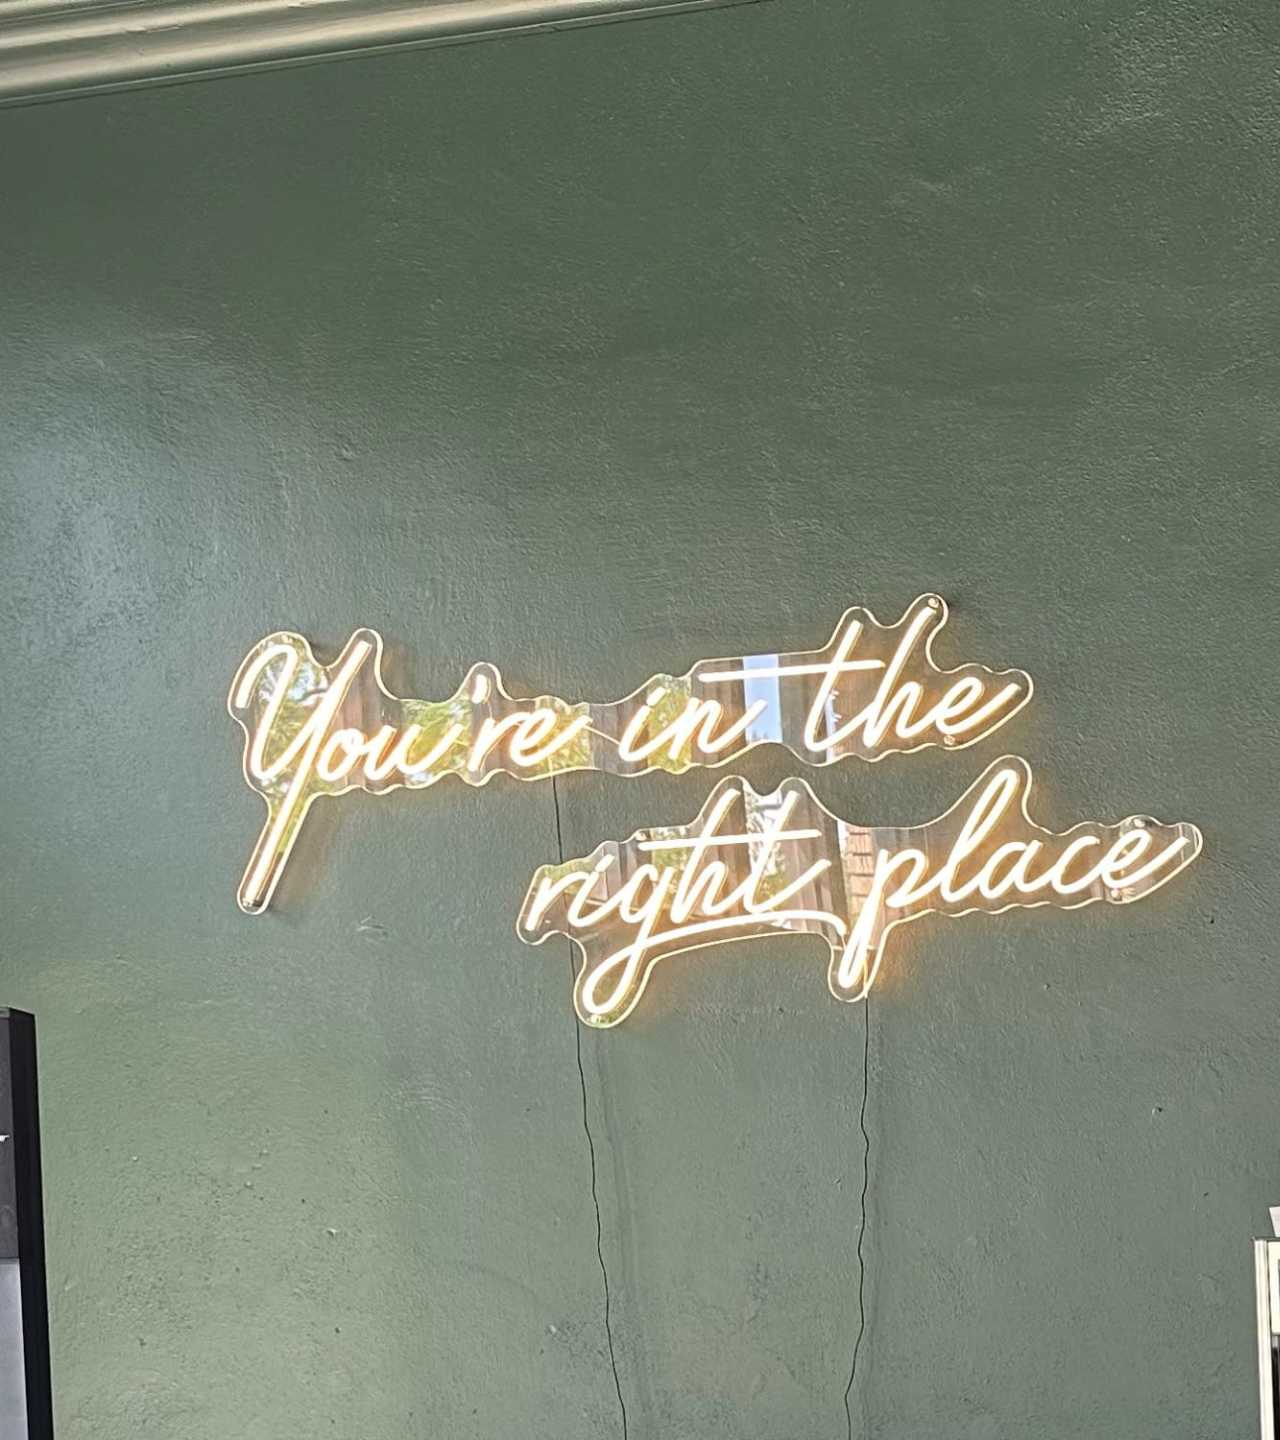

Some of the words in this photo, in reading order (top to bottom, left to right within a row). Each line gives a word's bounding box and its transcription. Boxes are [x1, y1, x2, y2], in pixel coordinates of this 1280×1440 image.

[234, 636, 594, 908] You're
[616, 676, 768, 762] in
[698, 604, 1022, 750] the
[526, 786, 846, 1015] right
[838, 766, 1192, 990] place
